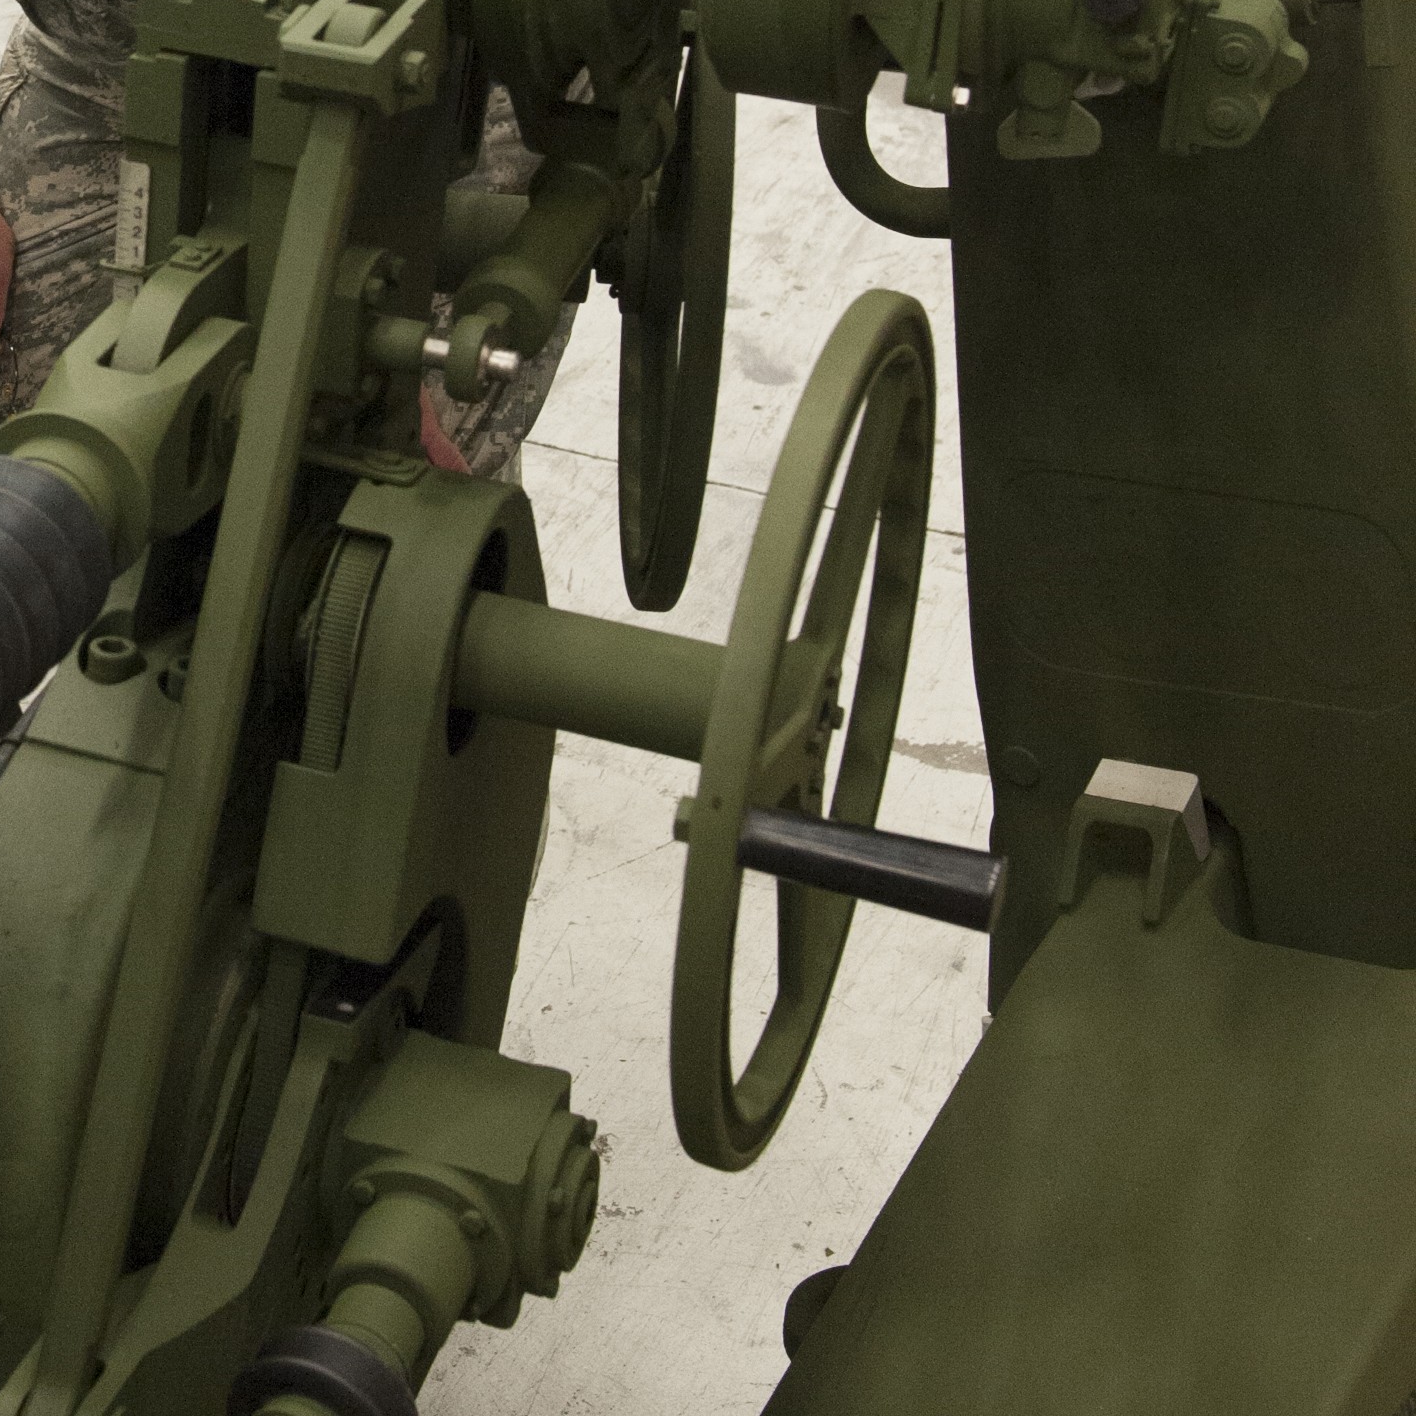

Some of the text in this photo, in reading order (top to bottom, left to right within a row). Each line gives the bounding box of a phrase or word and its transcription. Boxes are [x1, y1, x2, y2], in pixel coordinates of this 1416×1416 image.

[134, 187, 143, 199] 4
[133, 206, 142, 219] 3
[132, 225, 142, 238] 2
